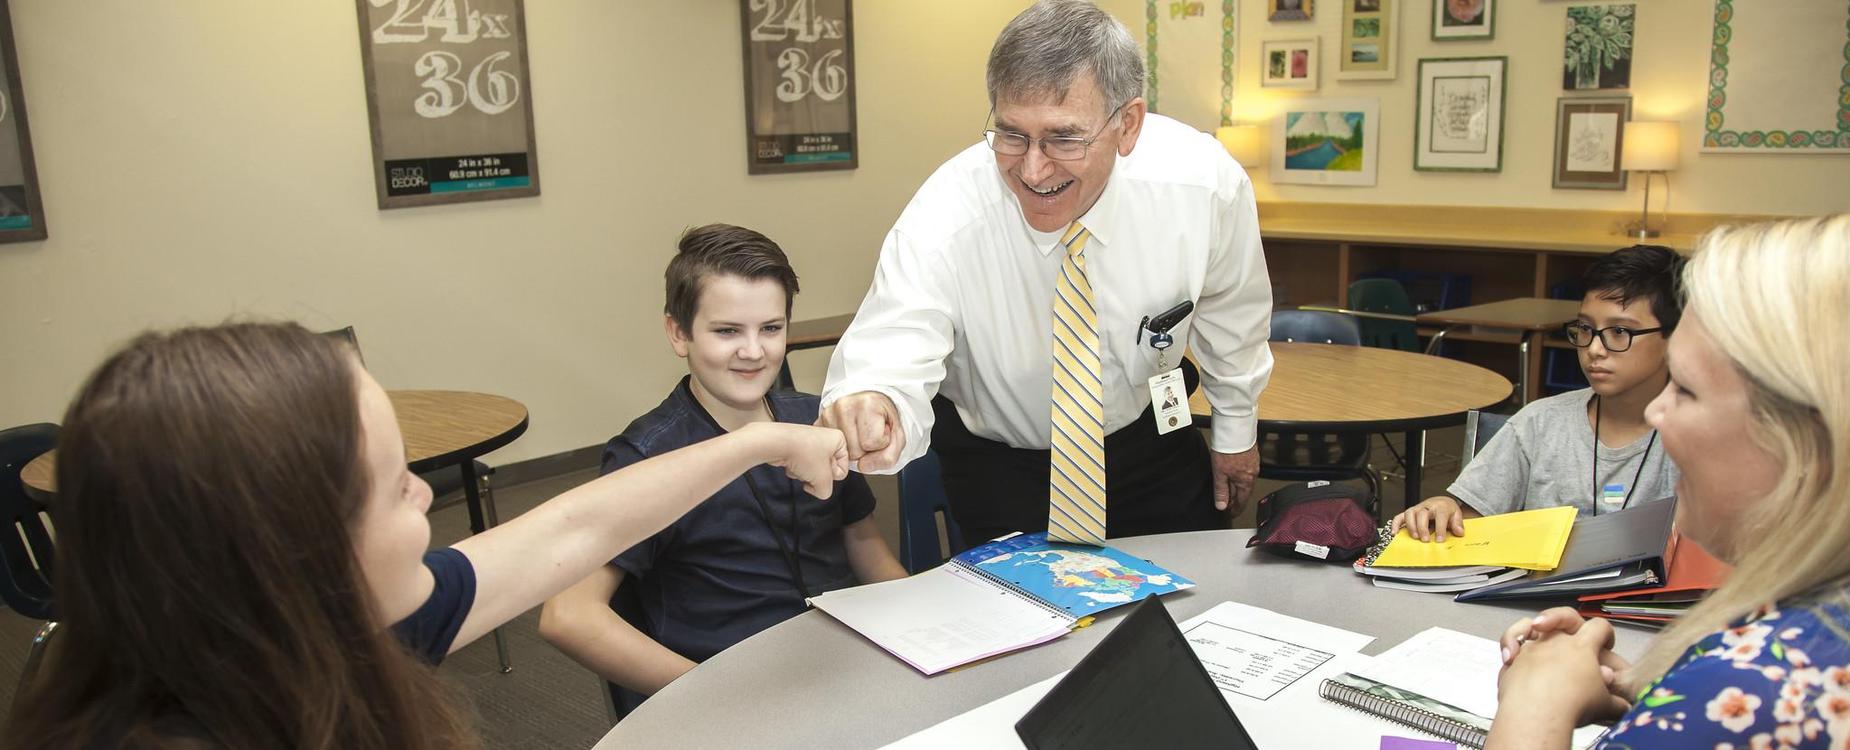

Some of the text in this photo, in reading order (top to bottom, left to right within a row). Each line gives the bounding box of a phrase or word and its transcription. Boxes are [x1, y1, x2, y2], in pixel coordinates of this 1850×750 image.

[414, 50, 520, 118] 36
[776, 47, 848, 102] 36
[458, 158, 468, 168] 24
[466, 170, 478, 178] cm
[499, 168, 511, 176] cm
